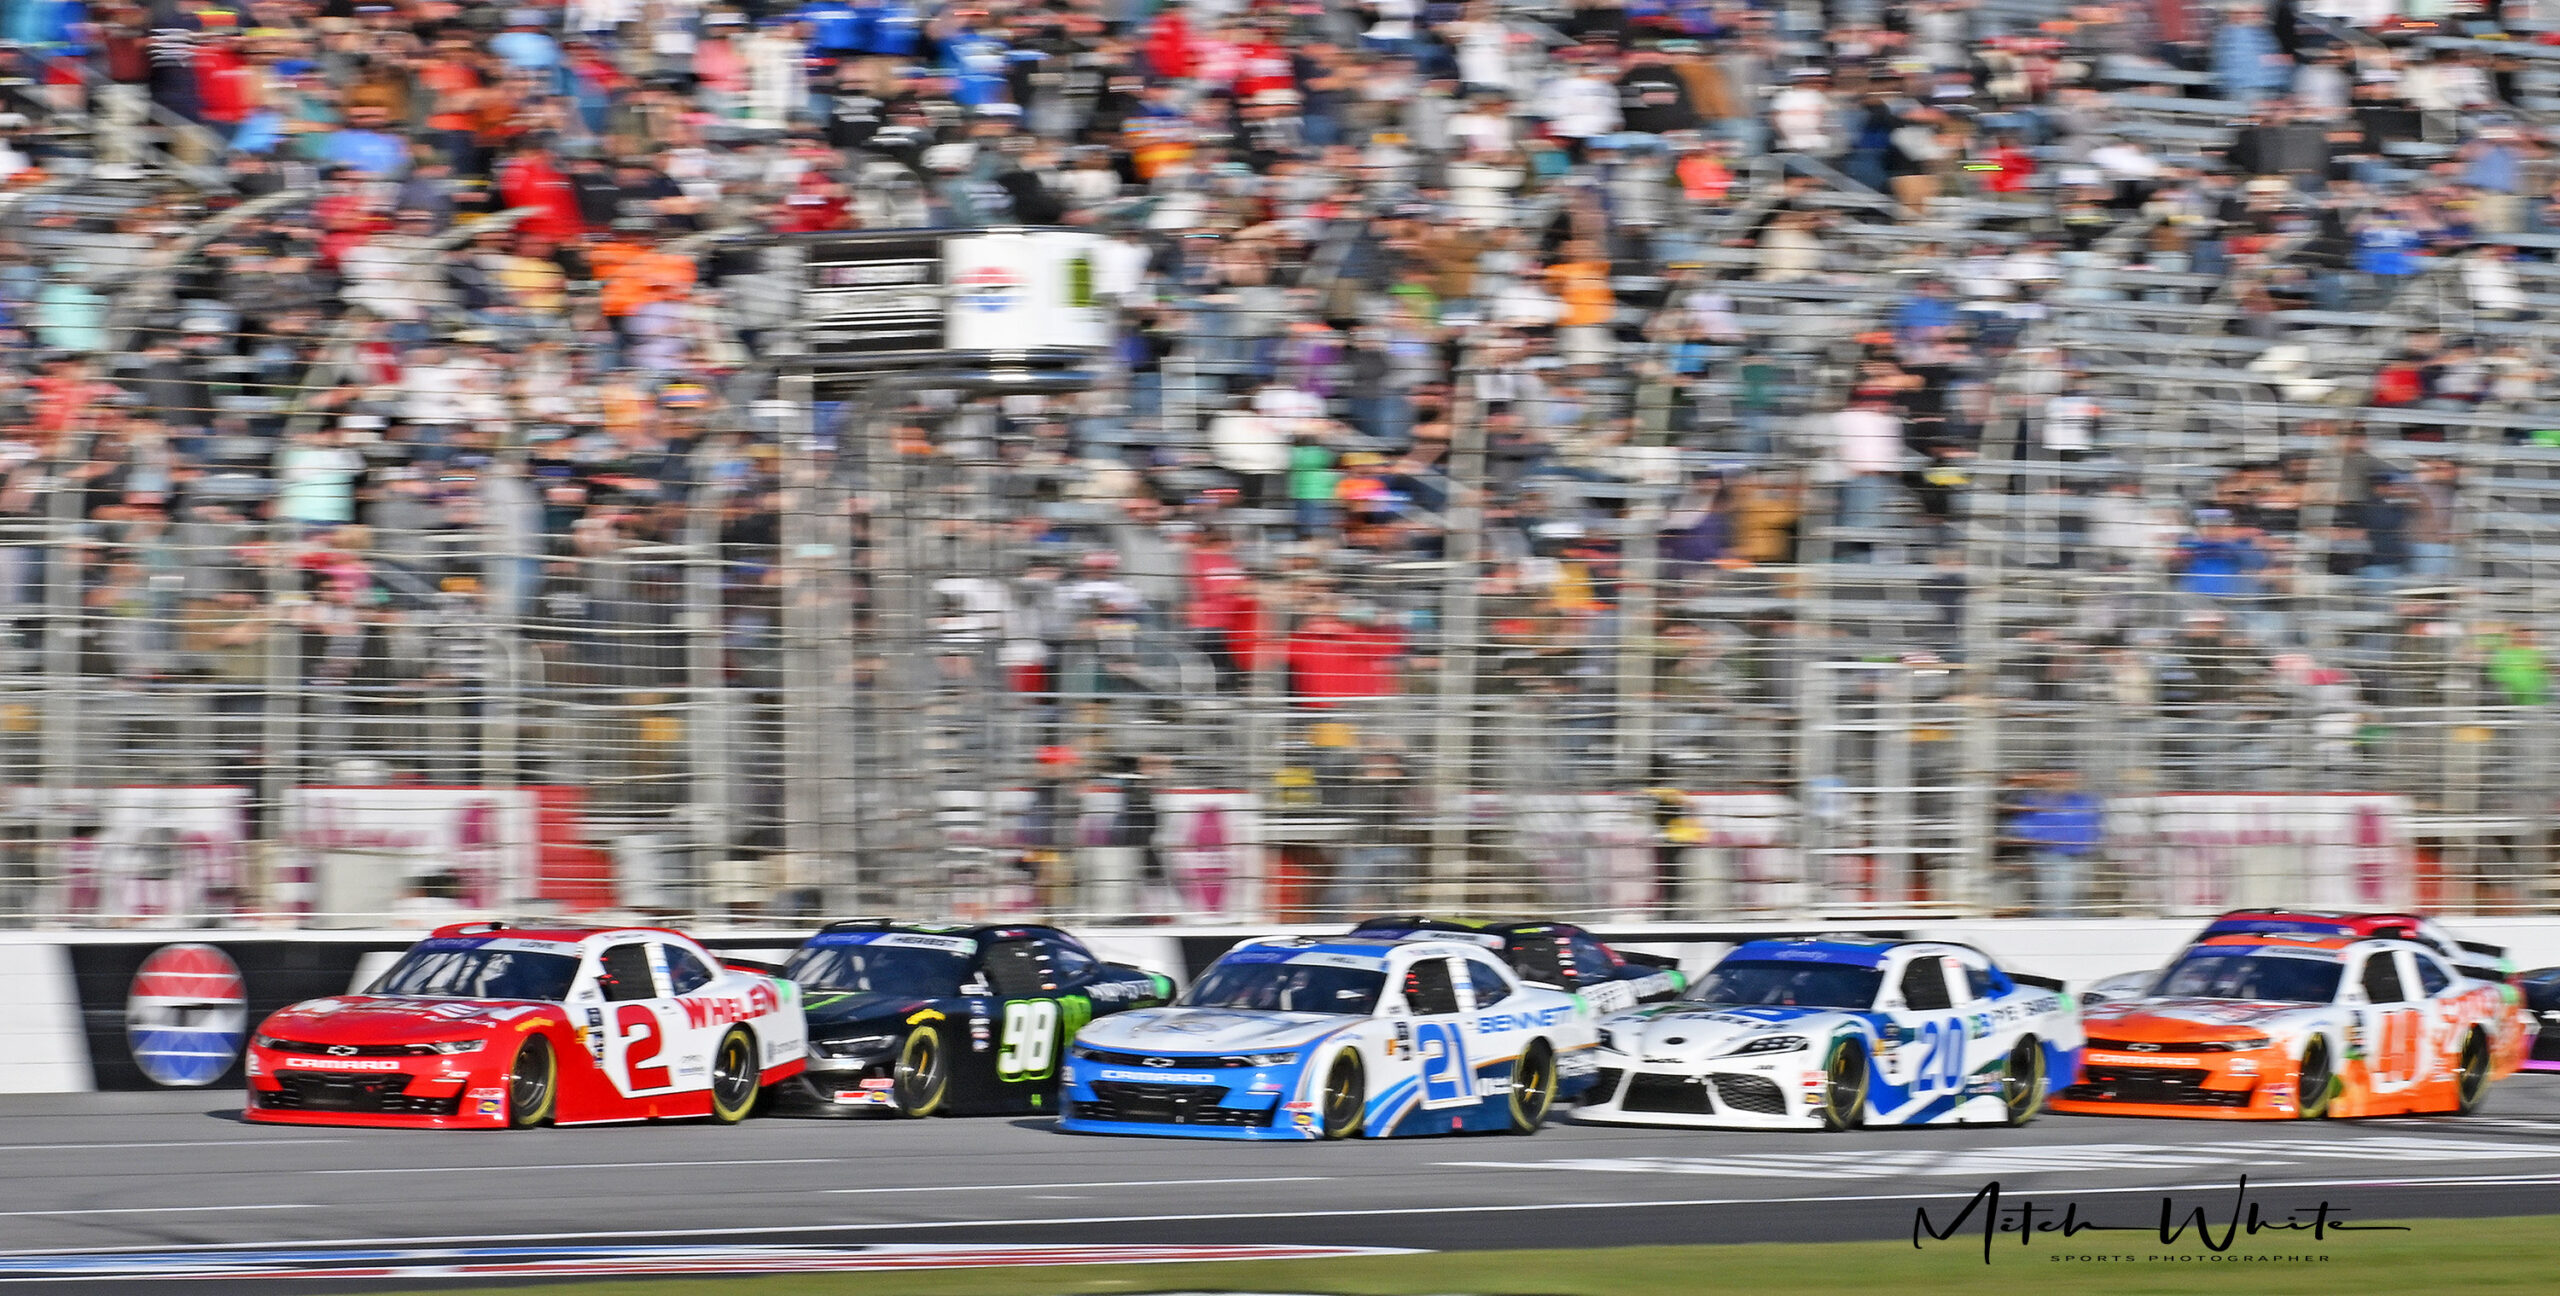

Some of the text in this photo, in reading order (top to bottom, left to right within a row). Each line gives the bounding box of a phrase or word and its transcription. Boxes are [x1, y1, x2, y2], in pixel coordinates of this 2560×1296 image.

[672, 985, 779, 1030] WHELEN
[998, 997, 1061, 1081] 98
[286, 1057, 400, 1070] CAMARO
[616, 1004, 673, 1092] 2
[1416, 1022, 1475, 1101] 21
[1917, 1016, 1966, 1092] 20
